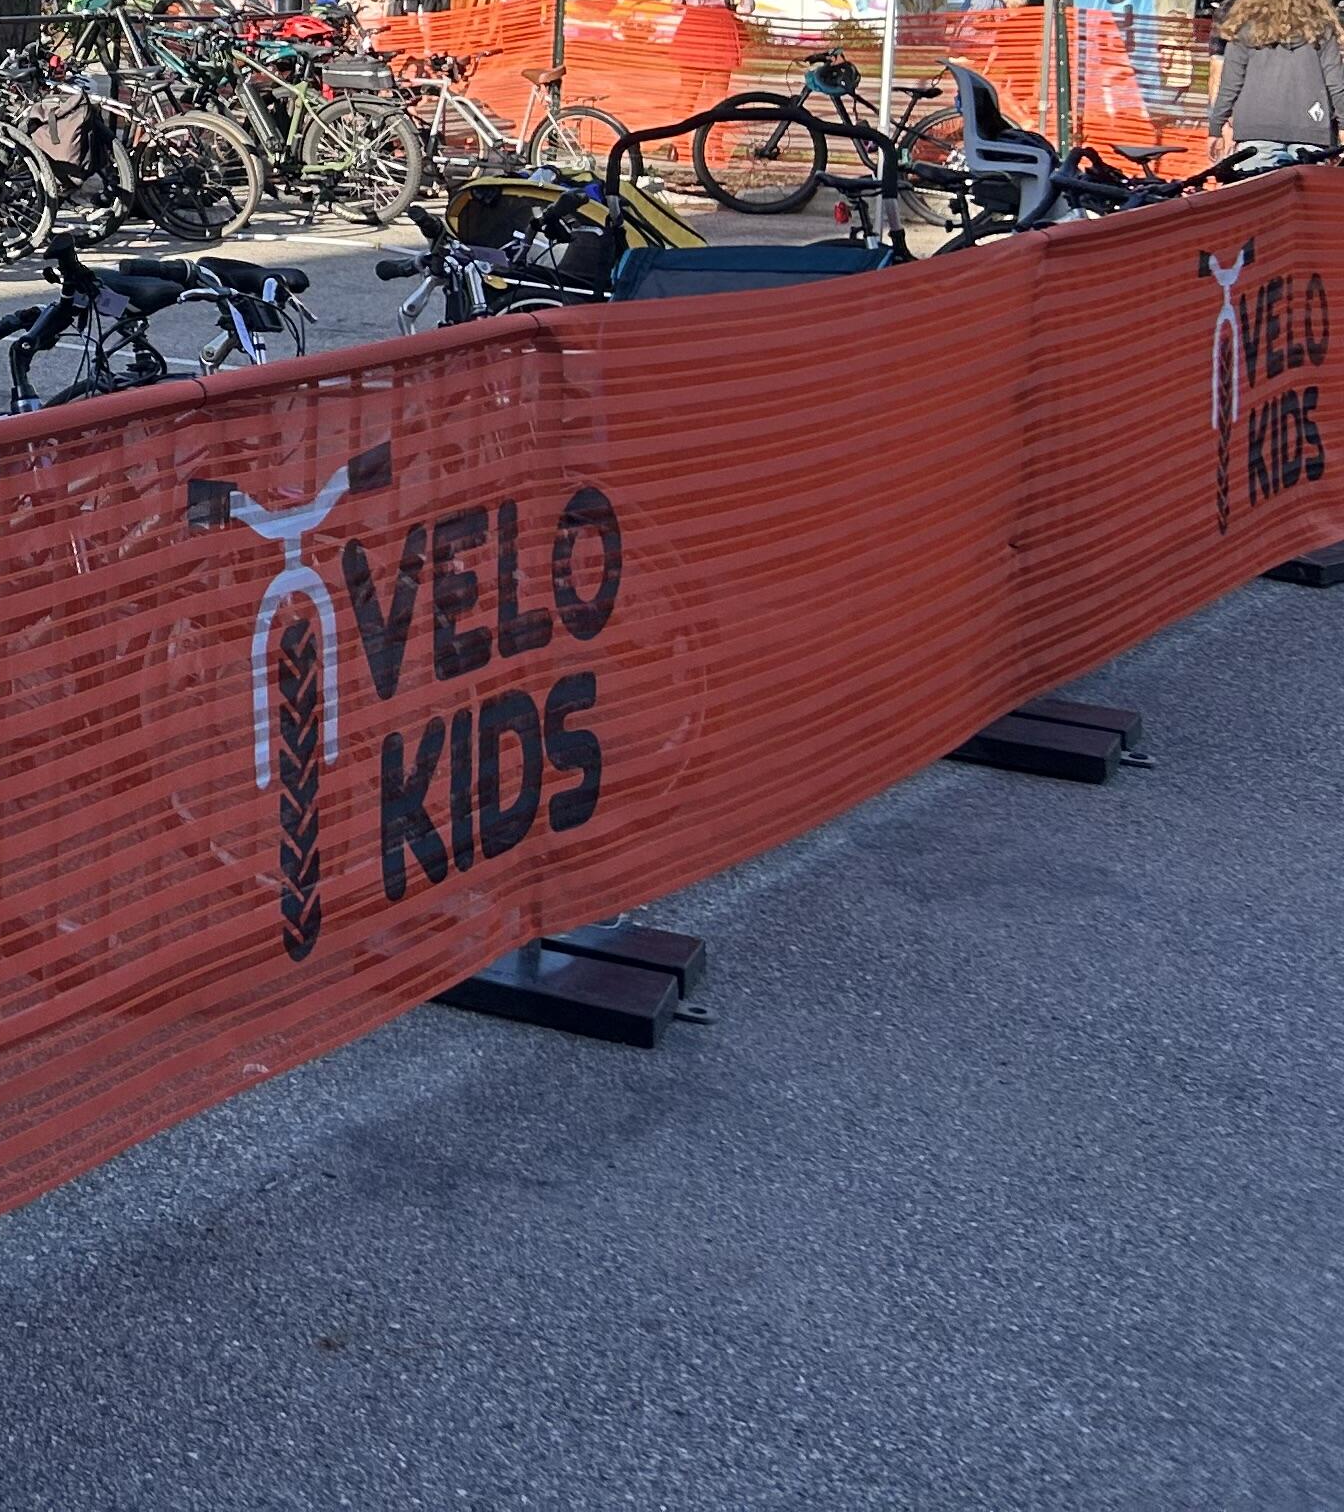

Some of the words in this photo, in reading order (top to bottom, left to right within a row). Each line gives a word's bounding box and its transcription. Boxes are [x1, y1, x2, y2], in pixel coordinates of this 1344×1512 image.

[1239, 272, 1329, 388] VELO
[1247, 385, 1326, 507] KIDS
[341, 487, 622, 700] VELO
[381, 671, 602, 901] KIDS
